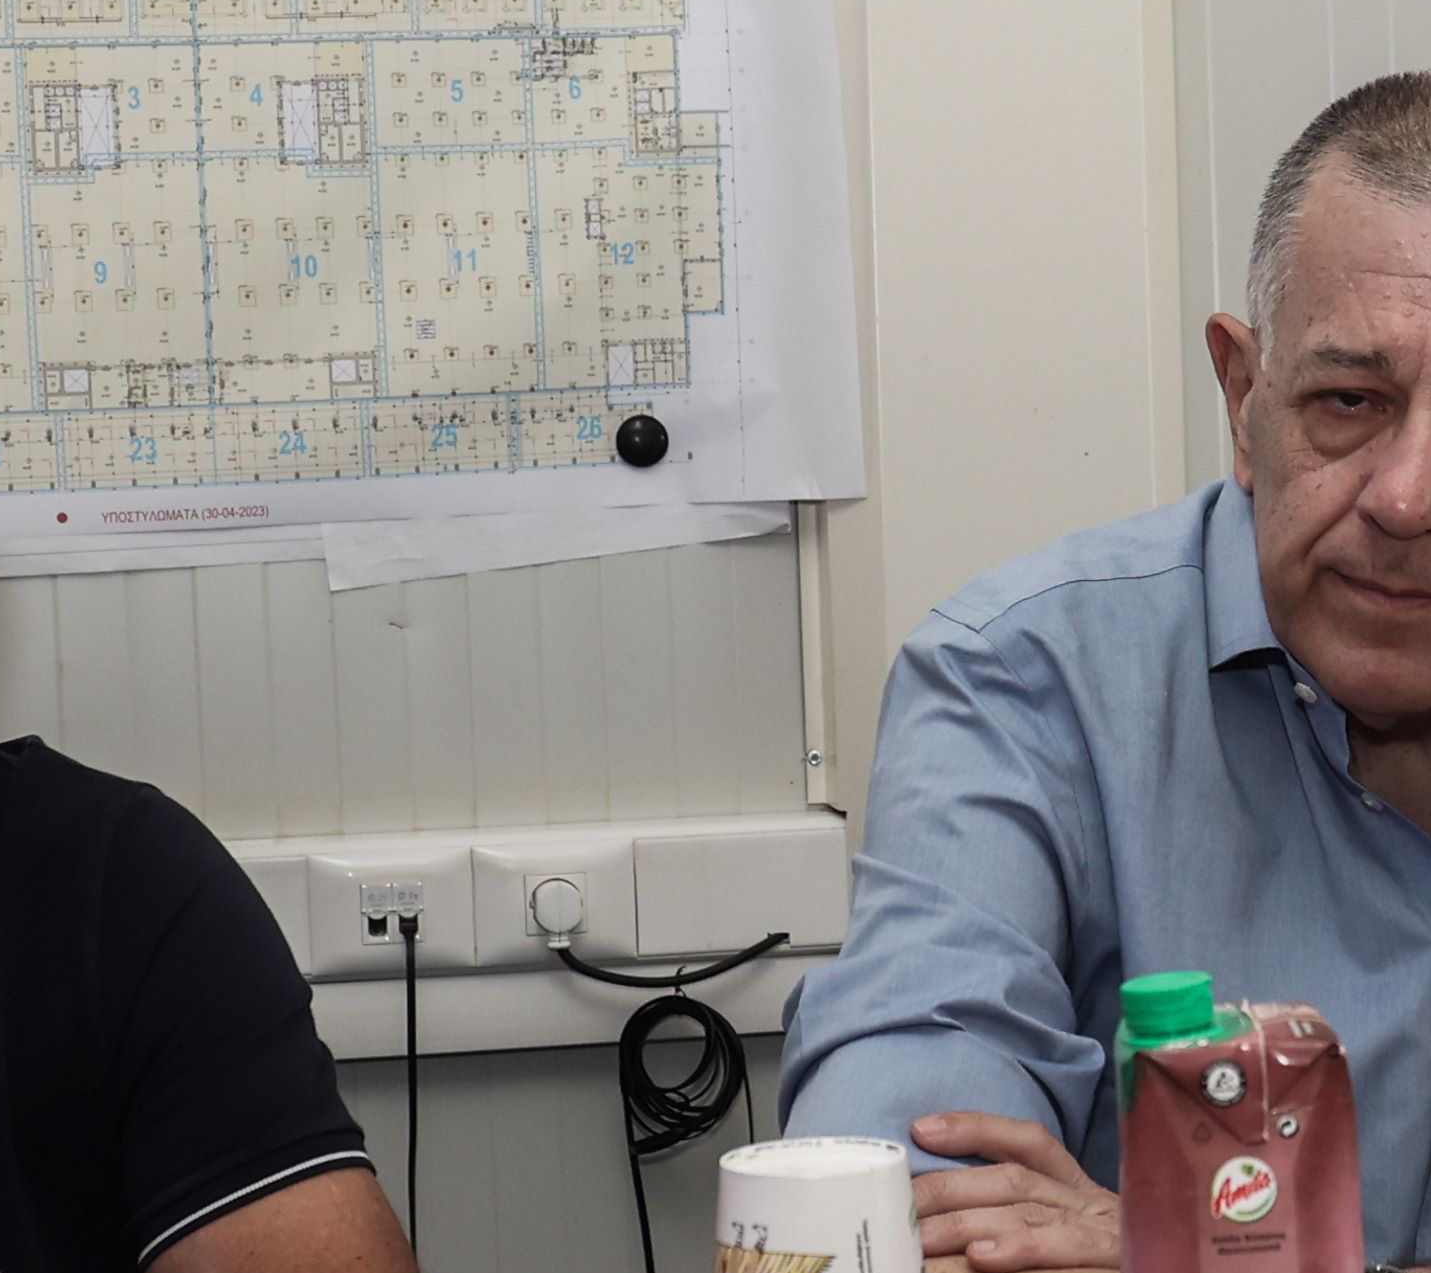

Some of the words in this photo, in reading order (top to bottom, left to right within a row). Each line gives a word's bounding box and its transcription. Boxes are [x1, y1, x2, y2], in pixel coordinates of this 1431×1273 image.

[129, 87, 141, 109] 3
[249, 84, 263, 105] 4
[451, 80, 464, 101] 5
[569, 78, 581, 99] 6
[453, 249, 478, 271] 11
[610, 242, 635, 265] 12
[94, 261, 107, 284] 9
[291, 255, 318, 278] 10
[431, 425, 458, 448] 25
[577, 417, 602, 440] 26
[130, 437, 158, 461] 23
[279, 431, 306, 454] 24
[101, 509, 199, 524] ΥΠΟΣΤΥΛΩΜΑΤΑ
[201, 505, 270, 521] (30-04-2023)
